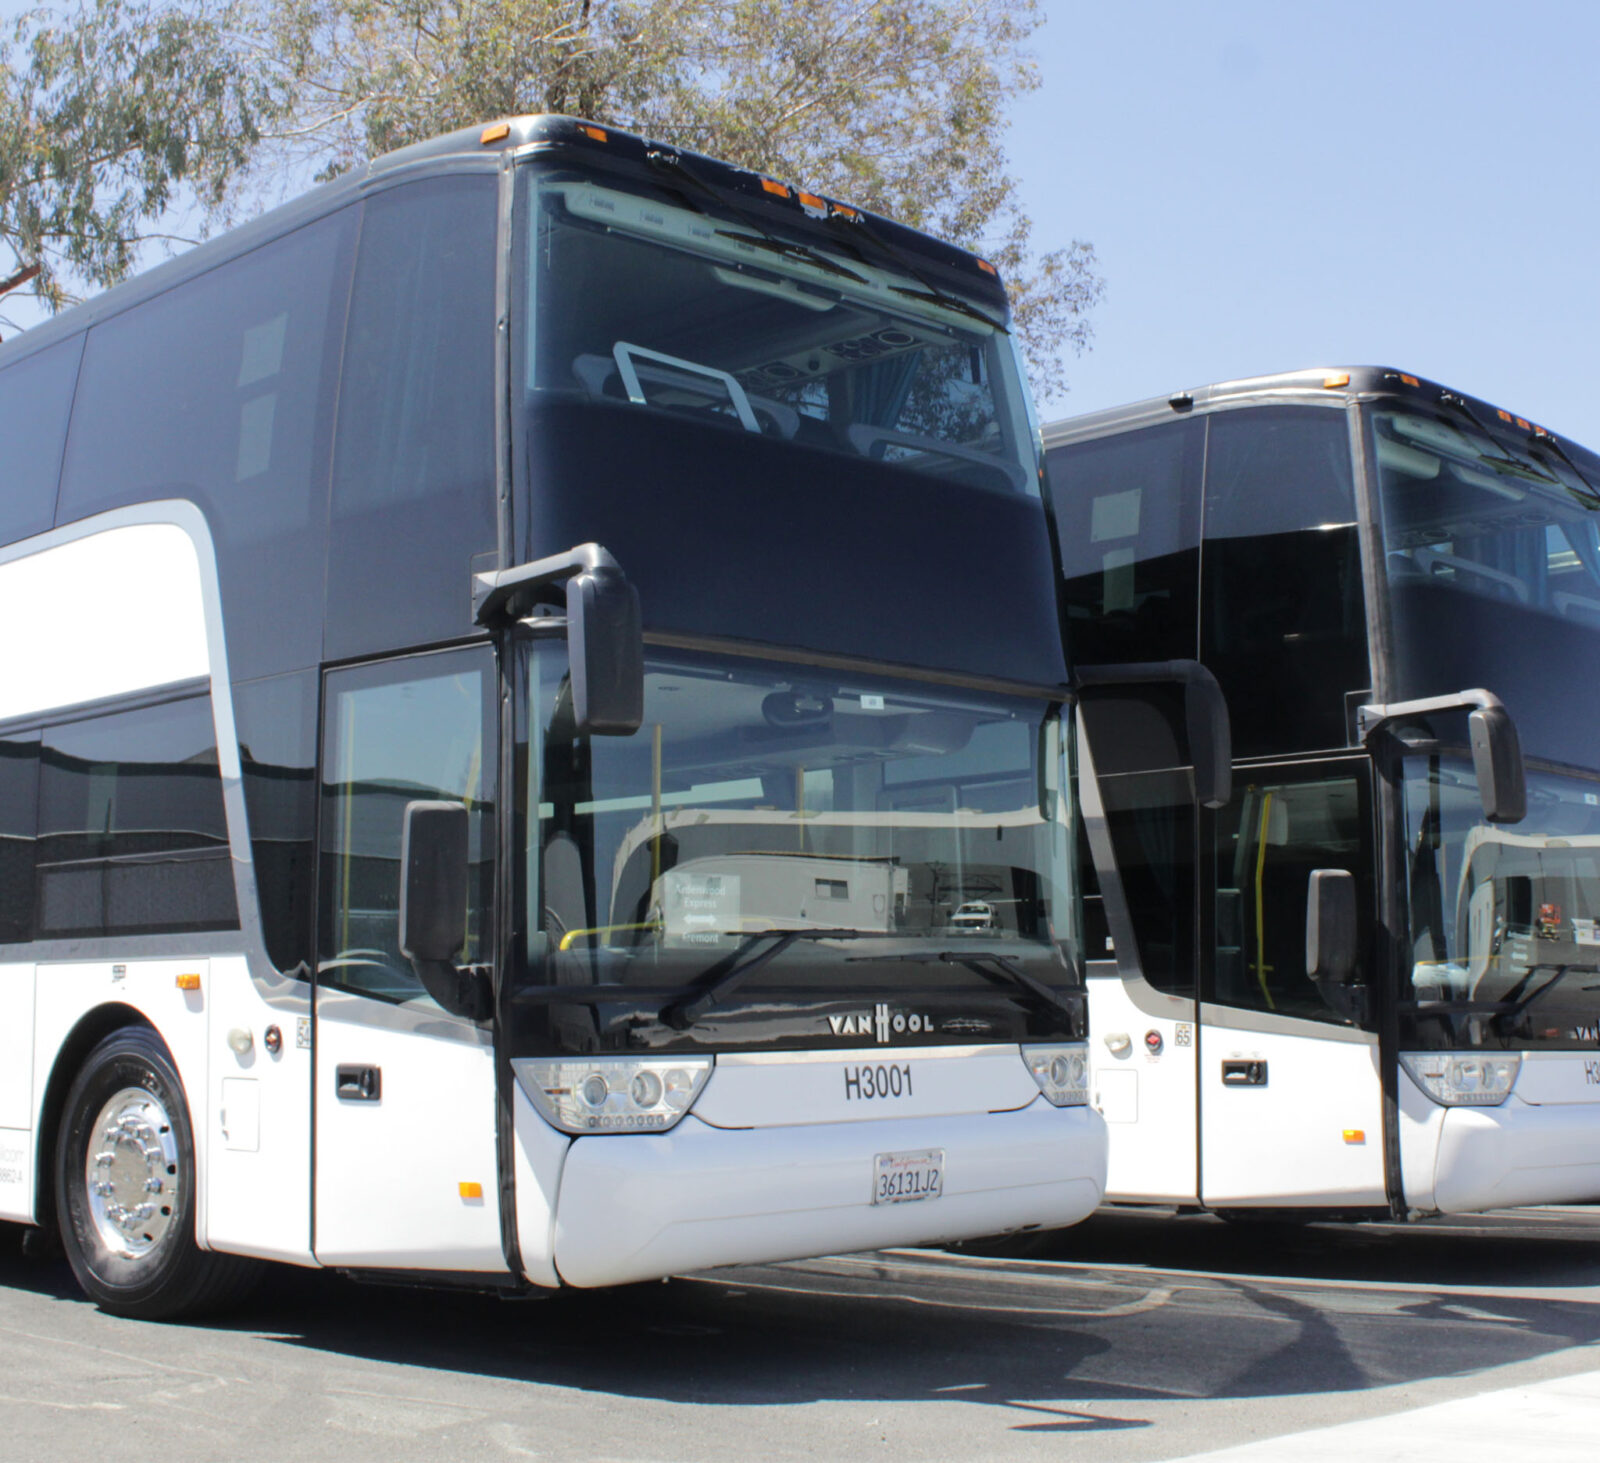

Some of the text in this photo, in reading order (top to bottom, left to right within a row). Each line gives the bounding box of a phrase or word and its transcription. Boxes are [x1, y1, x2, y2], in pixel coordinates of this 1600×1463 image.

[682, 932, 719, 944] Fremont
[1176, 1029, 1190, 1045] 65
[845, 1064, 912, 1100] H3001
[879, 1168, 939, 1197] 36131J2
